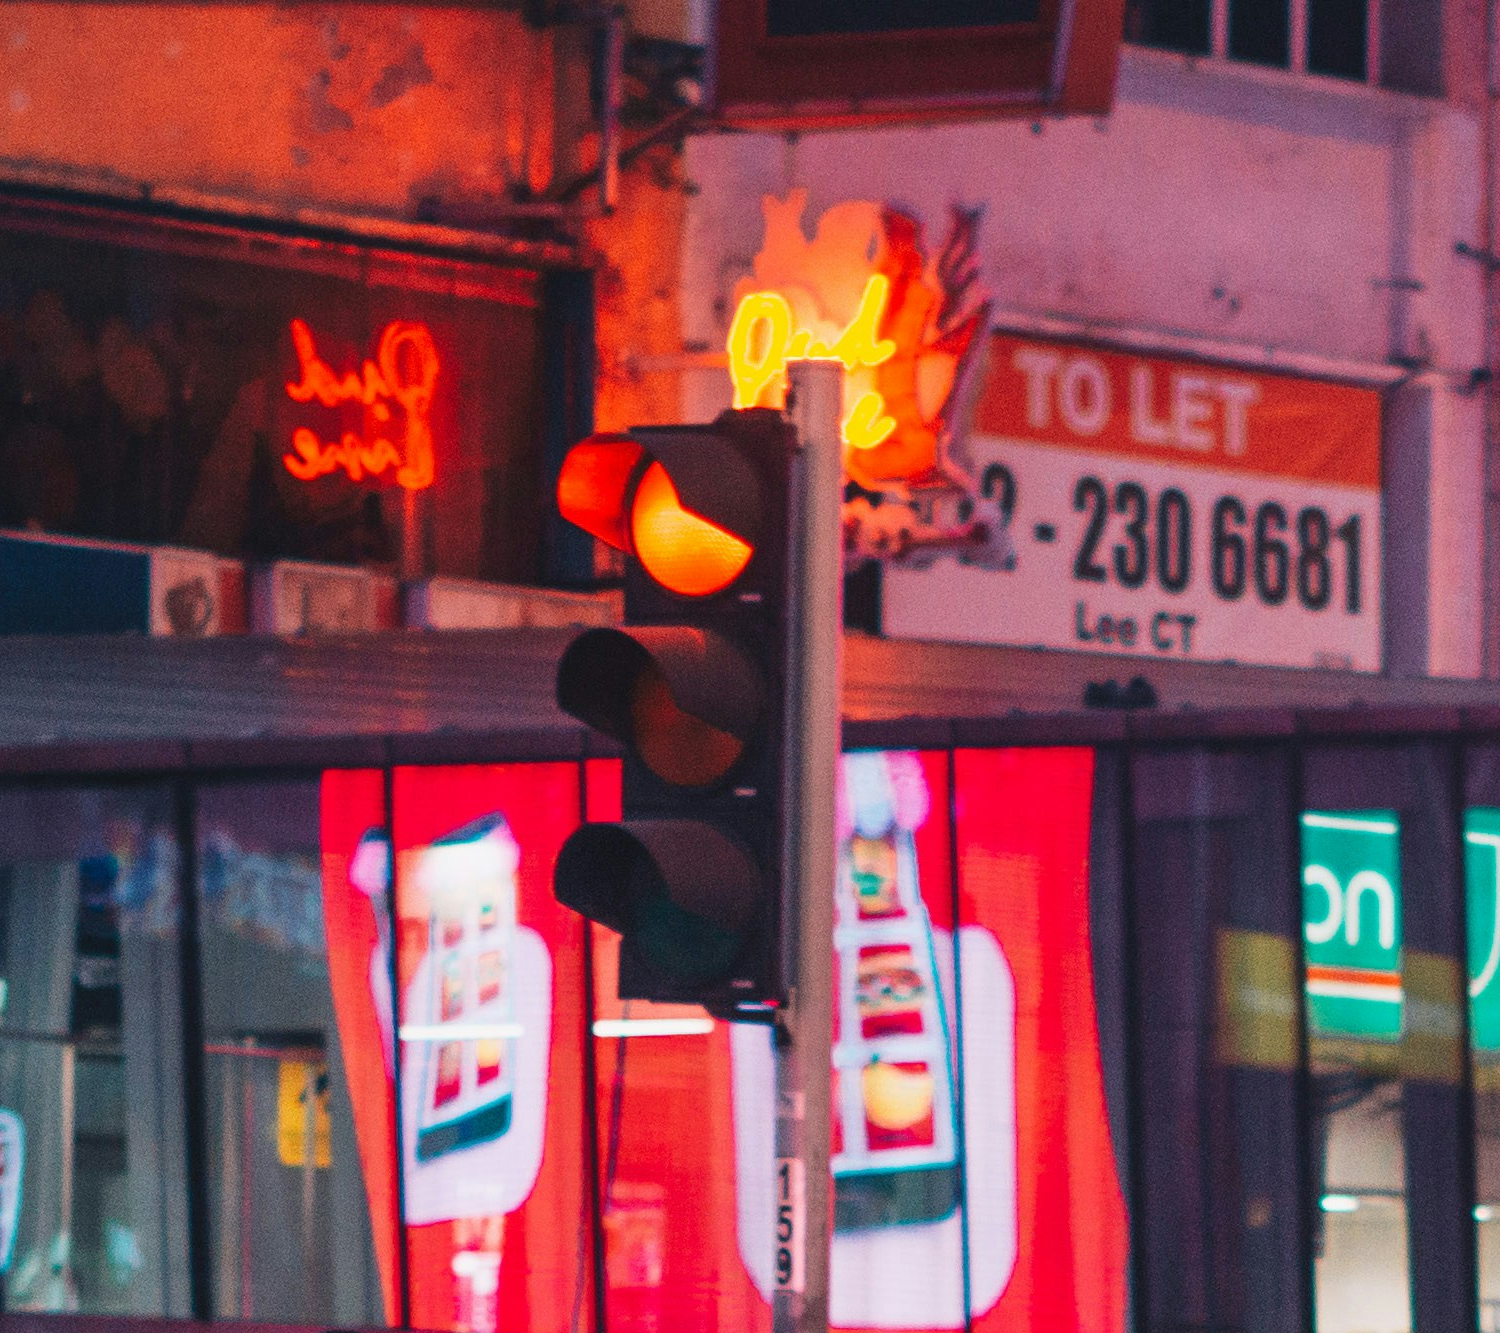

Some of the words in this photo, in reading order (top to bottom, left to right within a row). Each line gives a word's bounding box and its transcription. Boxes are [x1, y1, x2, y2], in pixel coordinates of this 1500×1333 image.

[1015, 350, 1112, 438] TO
[1130, 371, 1265, 457] LET
[1073, 474, 1194, 593] 230
[1211, 494, 1363, 615] 6681
[1074, 599, 1138, 647] Lee
[1152, 610, 1197, 652] CT
[777, 1161, 794, 1284] 159
